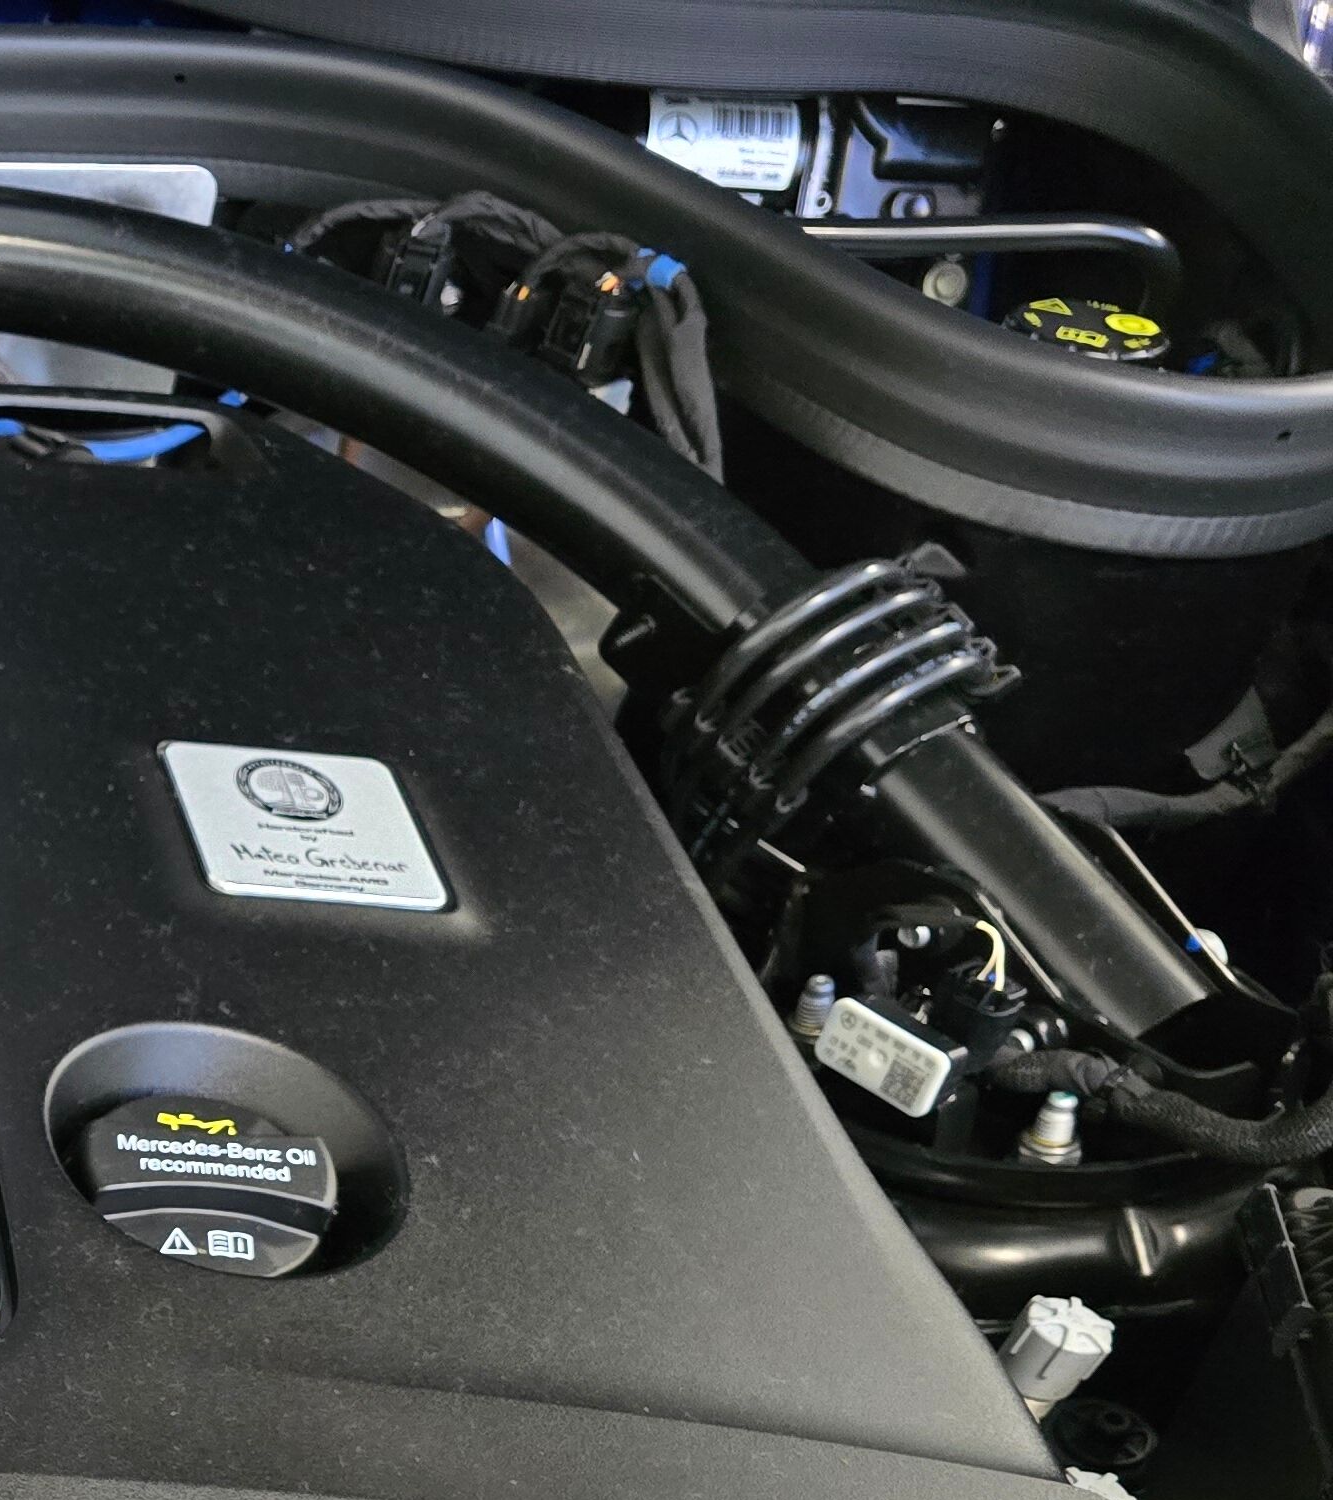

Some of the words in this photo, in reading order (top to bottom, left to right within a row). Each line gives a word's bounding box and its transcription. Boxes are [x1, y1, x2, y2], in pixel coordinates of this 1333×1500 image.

[116, 1133, 283, 1166] Mercedes-Benz
[285, 1147, 316, 1167] Oil
[139, 1155, 291, 1183] recommended
